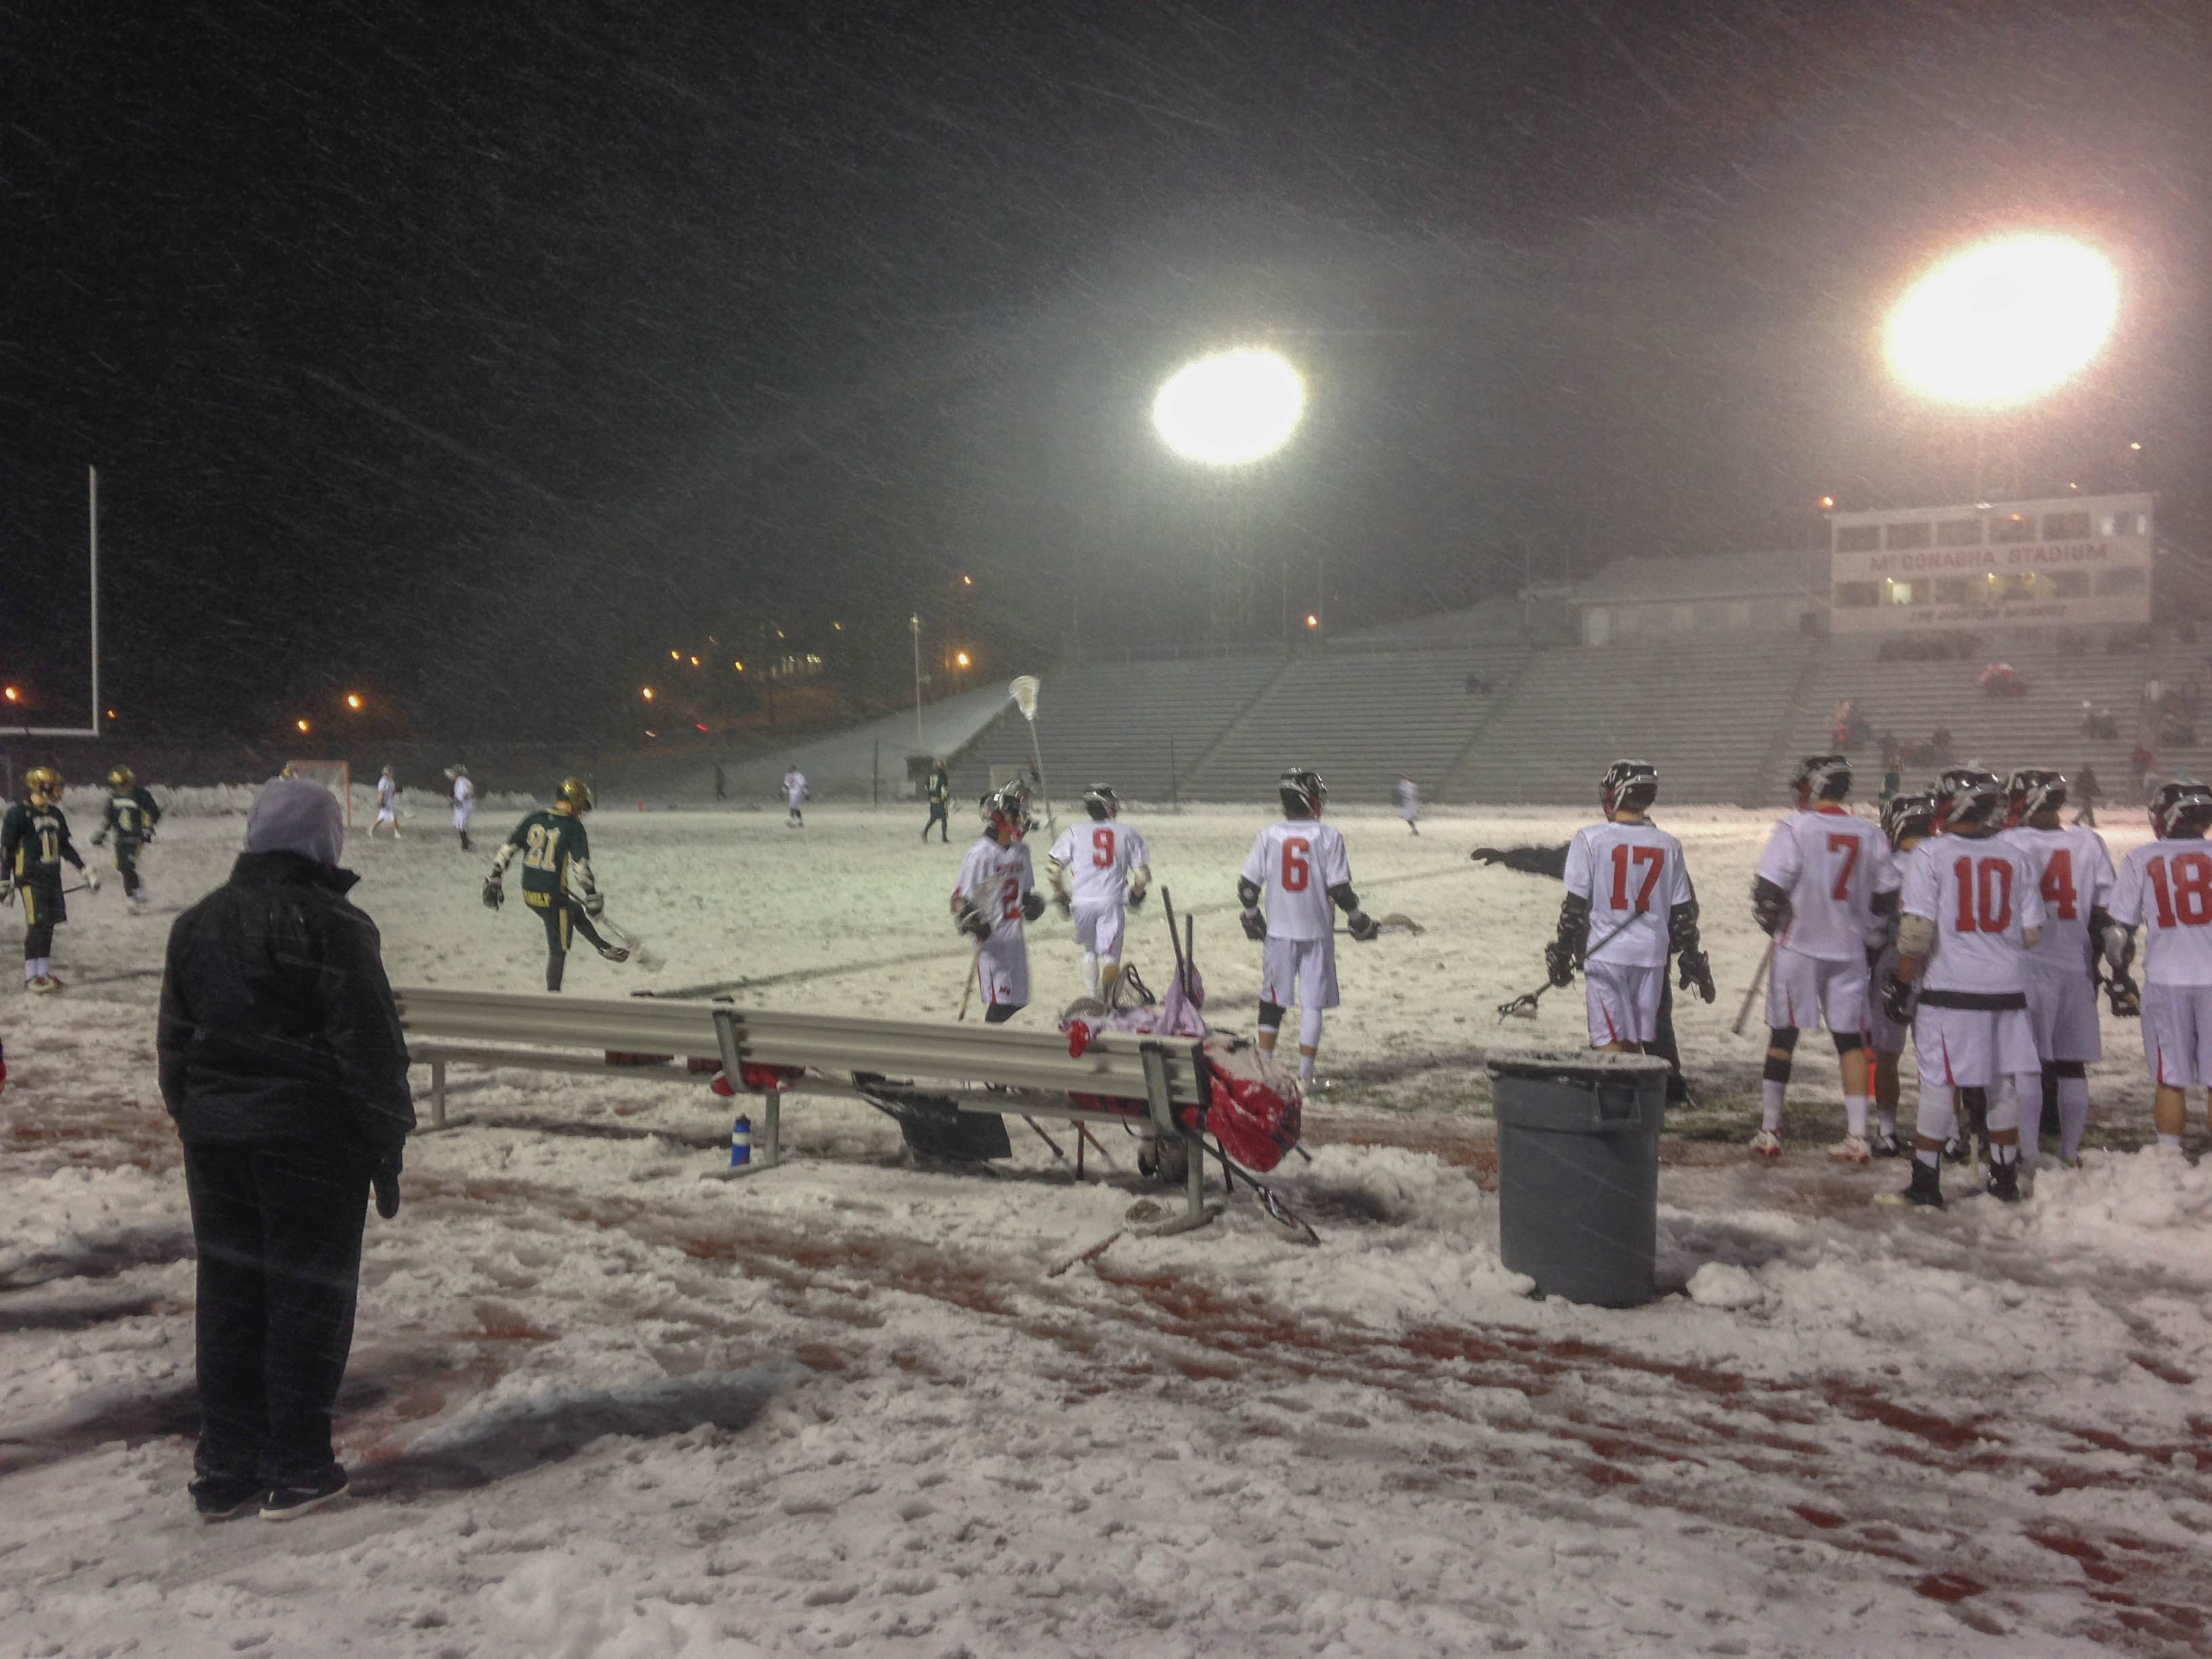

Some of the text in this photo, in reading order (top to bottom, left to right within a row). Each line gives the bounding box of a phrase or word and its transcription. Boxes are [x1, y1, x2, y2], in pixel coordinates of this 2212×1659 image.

[2009, 544, 2106, 564] STADIUM
[524, 823, 561, 873] 21
[1092, 827, 1115, 869] 9
[1282, 837, 1310, 892] 6
[1610, 844, 1665, 912] 17
[1827, 834, 1860, 901] 7
[1954, 857, 2013, 933] 10
[2040, 849, 2077, 920] 4
[2146, 852, 2212, 928] 18
